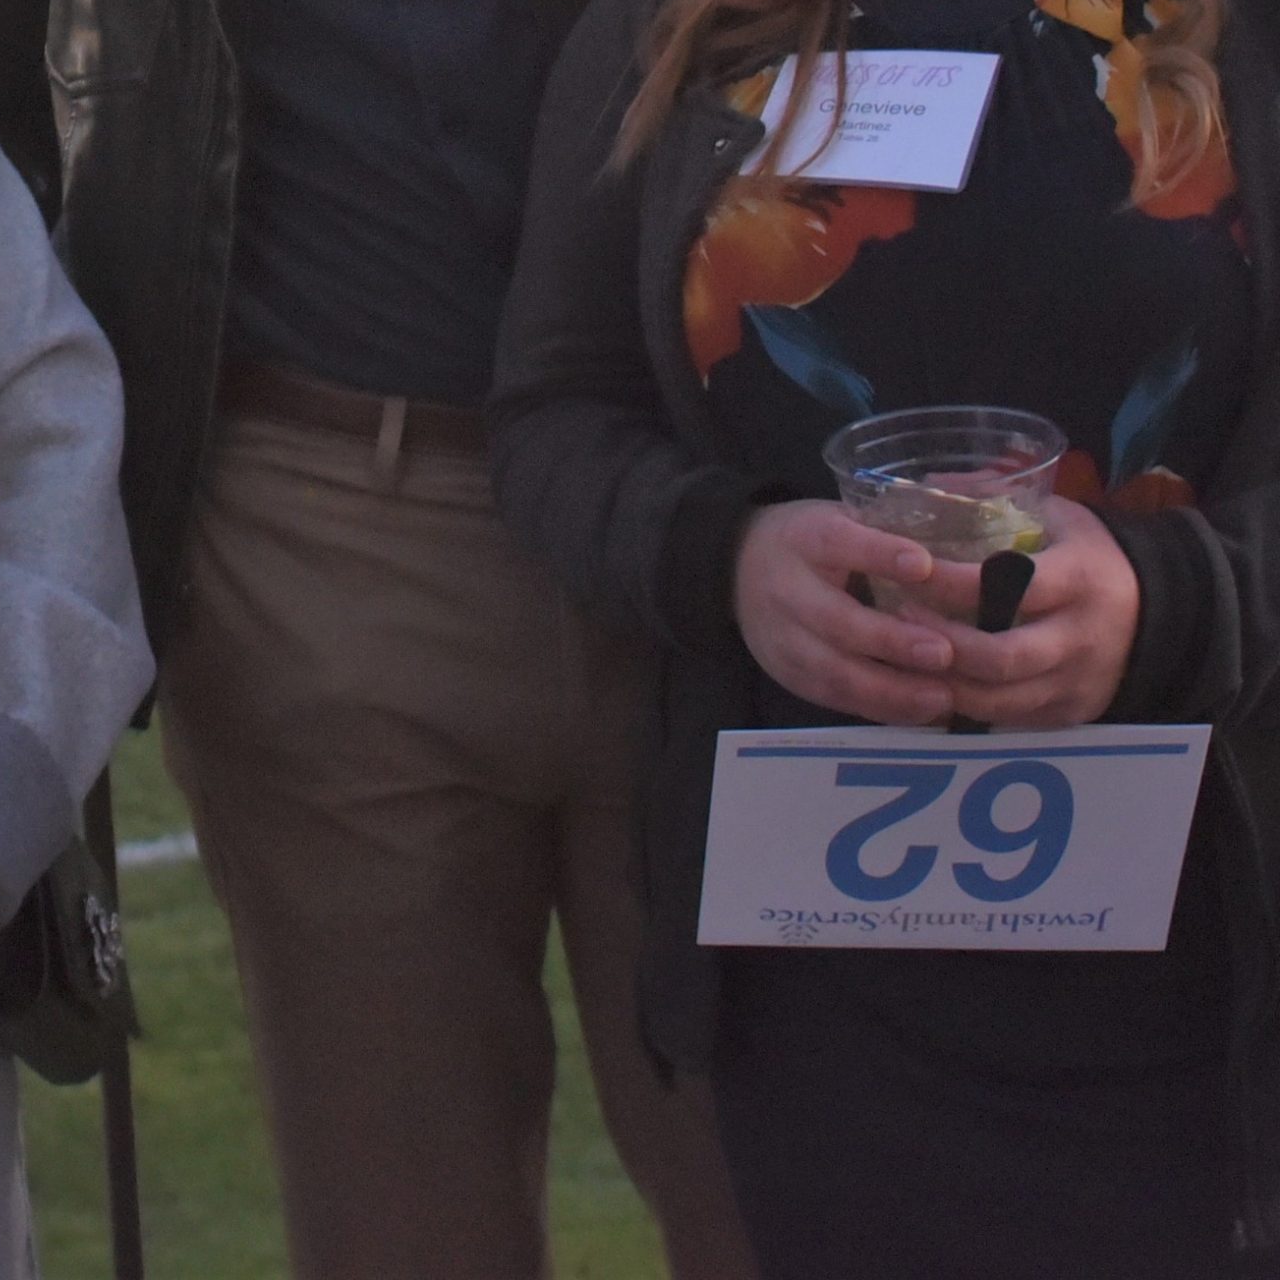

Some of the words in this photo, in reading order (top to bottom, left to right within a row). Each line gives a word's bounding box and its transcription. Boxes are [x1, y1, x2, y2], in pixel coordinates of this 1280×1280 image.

[876, 64, 910, 86] OF
[911, 64, 962, 87] JFS
[819, 98, 926, 116] Gnevieve
[824, 760, 1074, 902] 62
